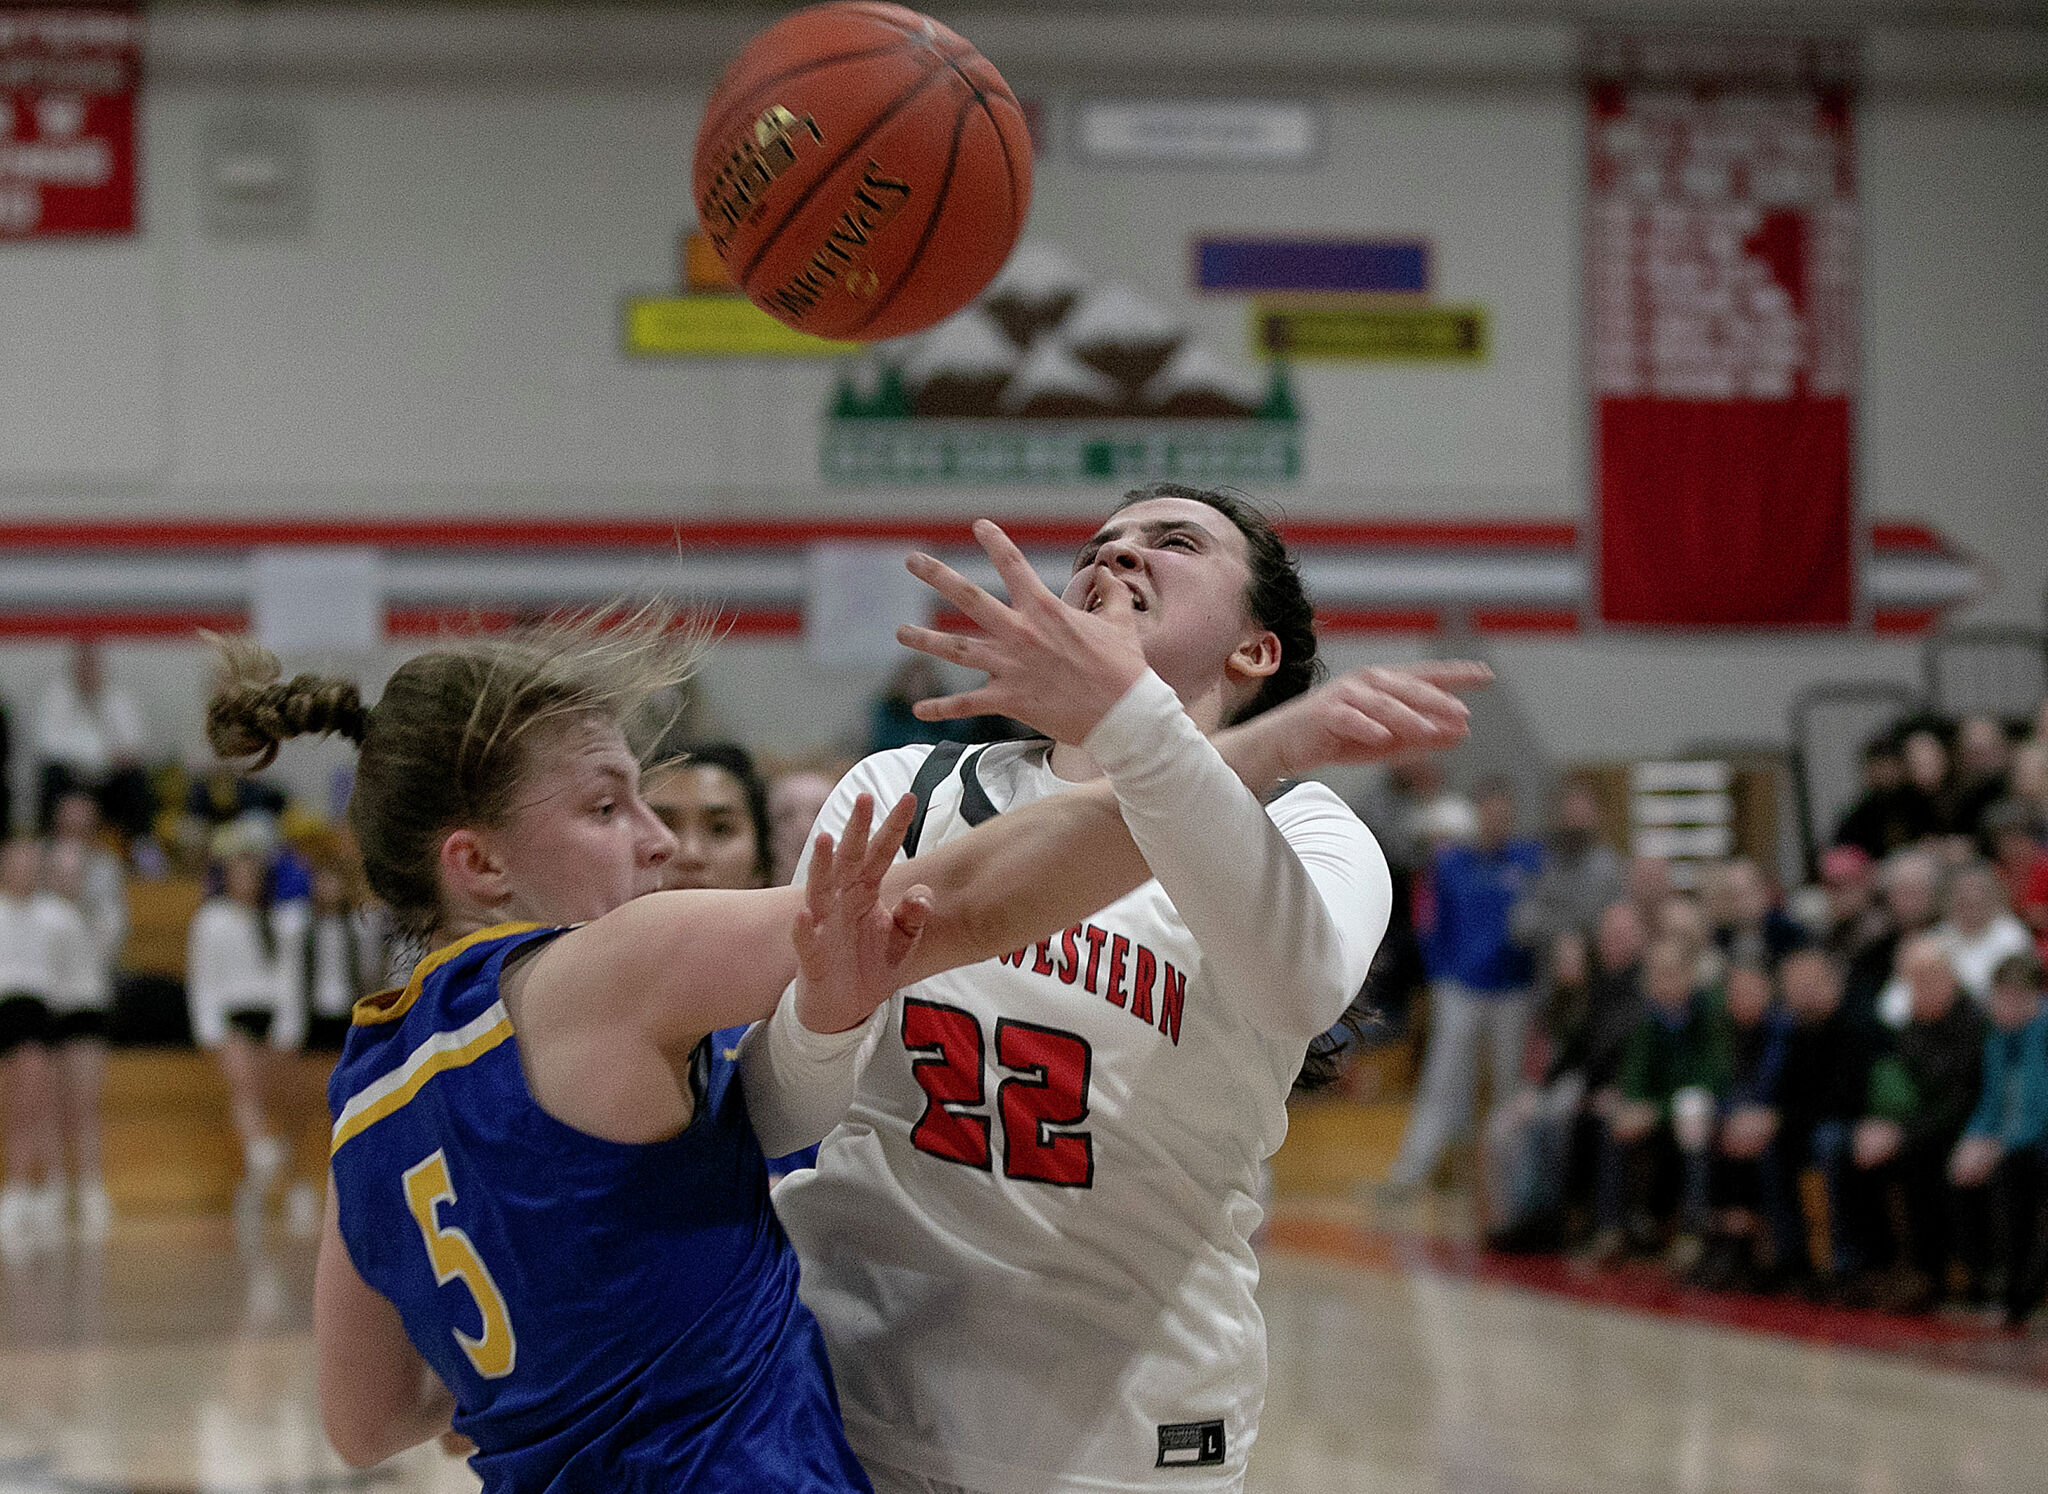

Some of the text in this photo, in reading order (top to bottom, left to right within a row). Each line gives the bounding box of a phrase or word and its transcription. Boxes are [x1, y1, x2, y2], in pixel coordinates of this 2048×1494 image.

[757, 157, 911, 319] SPALDIN
[999, 922, 1187, 1047] ESTERN
[901, 996, 1094, 1189] 22
[401, 1146, 517, 1381] 5
